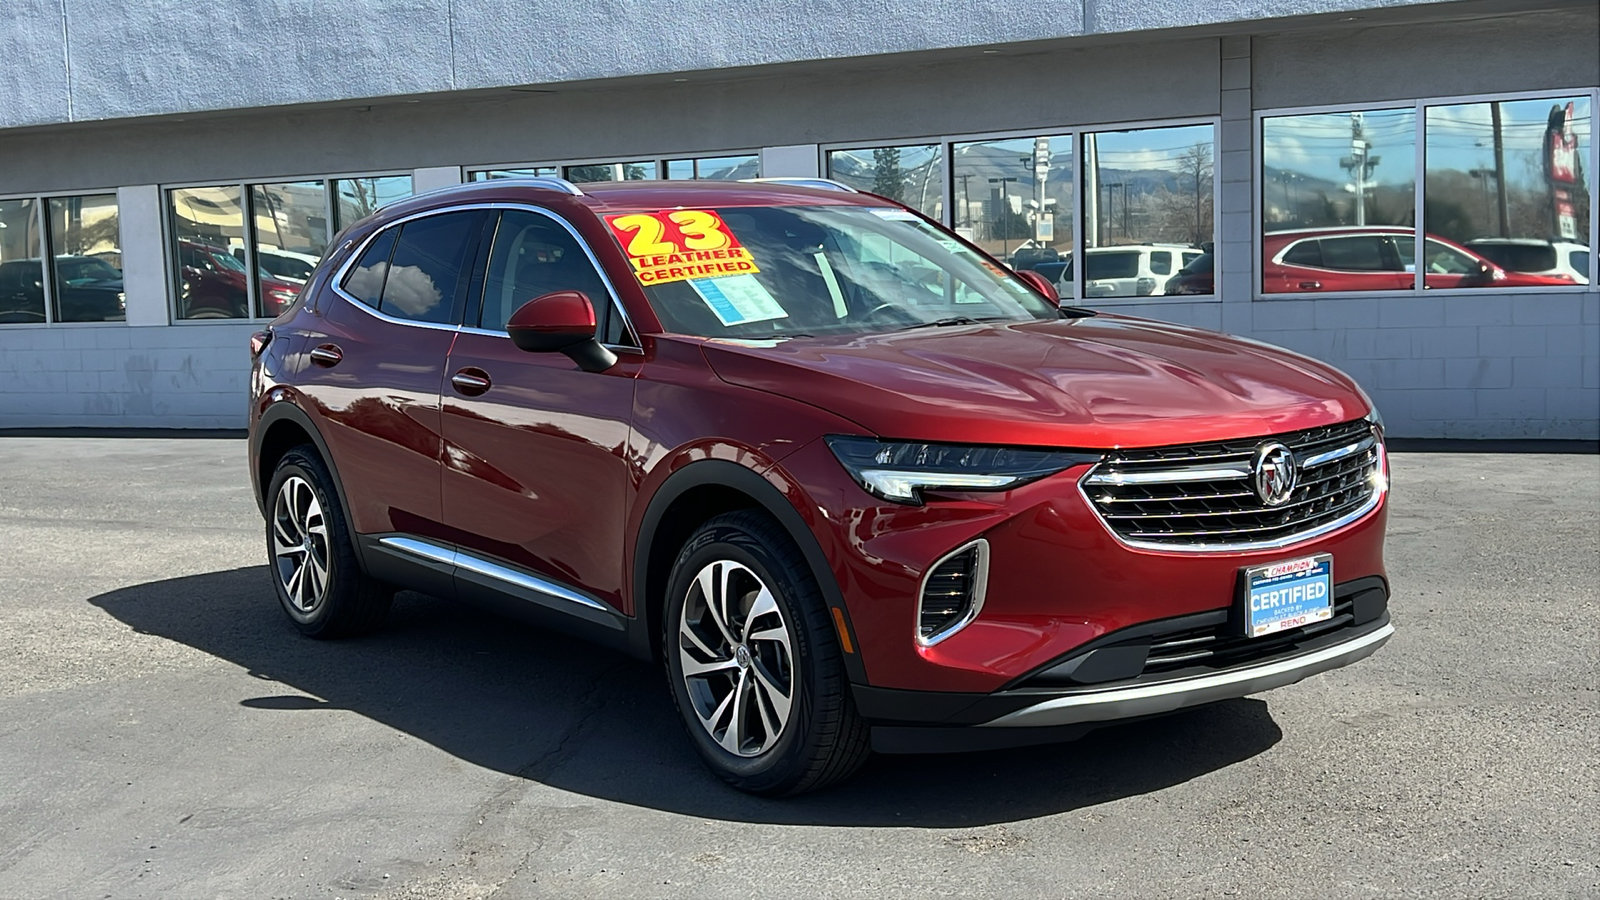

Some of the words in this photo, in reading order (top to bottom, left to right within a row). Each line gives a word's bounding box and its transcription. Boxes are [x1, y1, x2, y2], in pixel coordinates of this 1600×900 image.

[612, 210, 731, 256] 23
[639, 249, 743, 269] LEATHER
[639, 262, 752, 282] CERTIFIED
[1271, 561, 1311, 575] CHAMPION
[1251, 581, 1326, 612] CERTIFIED
[1274, 606, 1294, 615] BACKED
[1280, 616, 1306, 629] RENO
